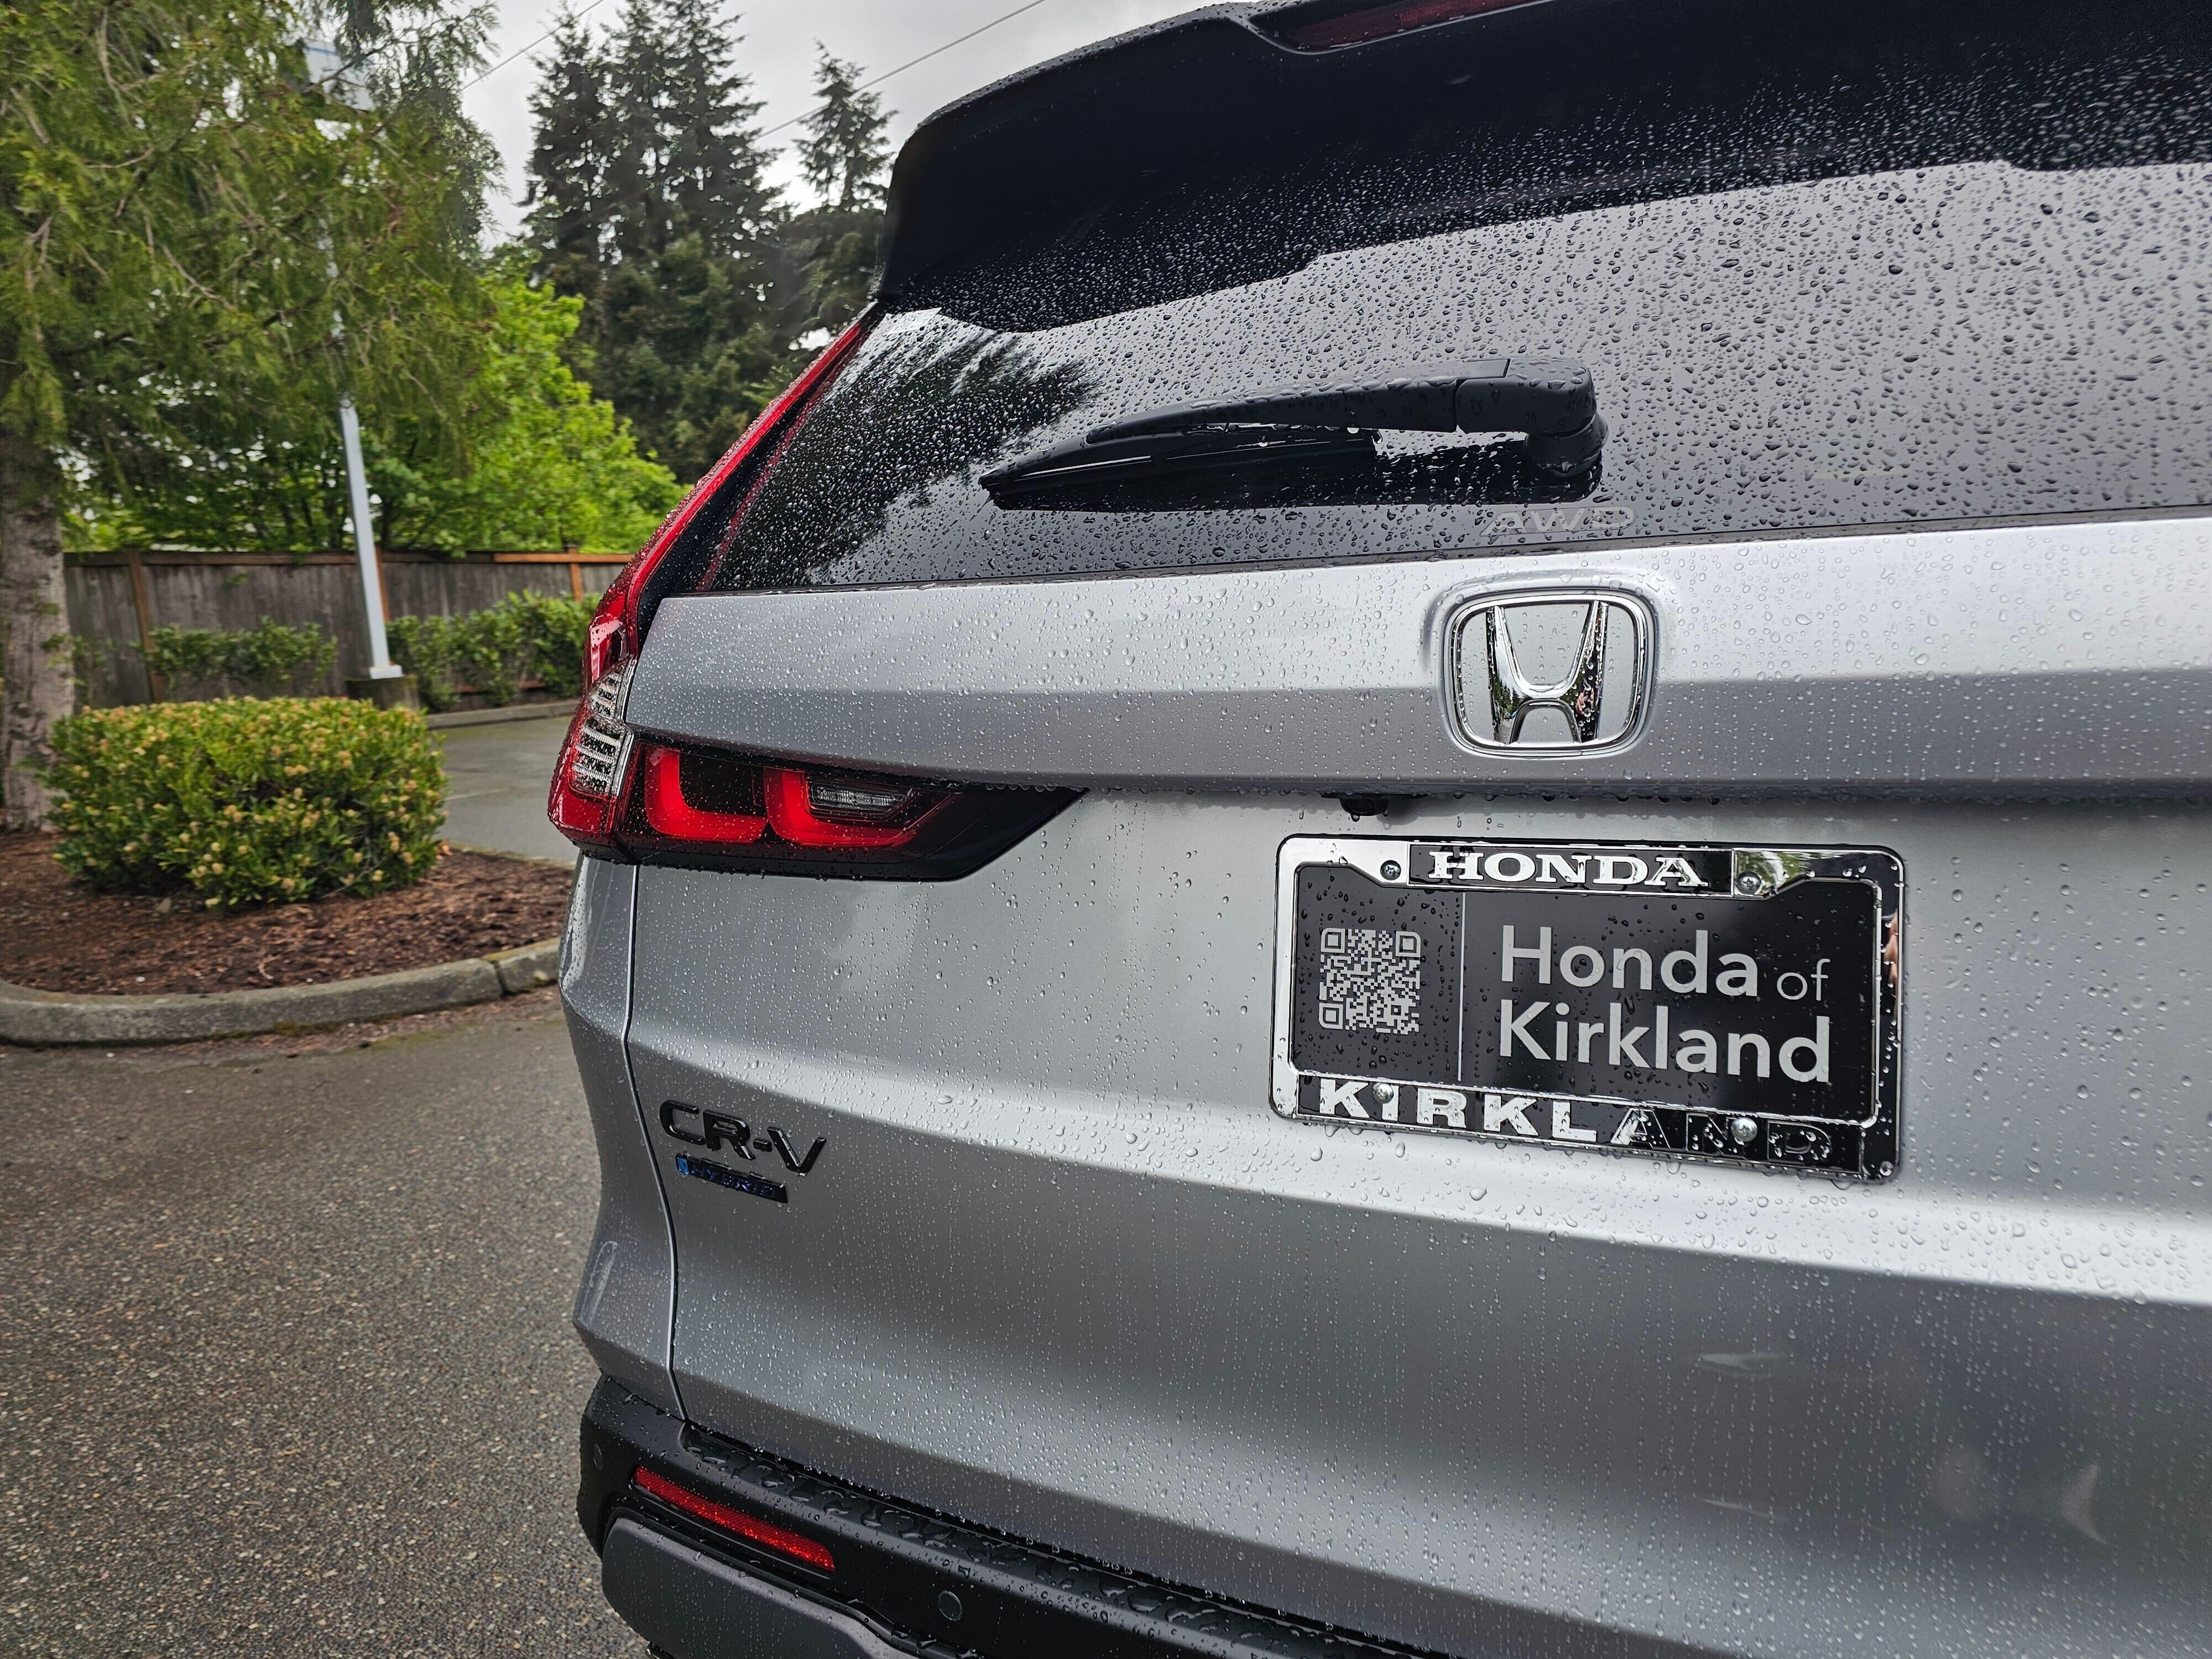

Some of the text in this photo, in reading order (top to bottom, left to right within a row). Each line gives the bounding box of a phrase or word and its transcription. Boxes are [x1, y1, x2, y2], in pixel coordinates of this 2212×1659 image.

[1480, 507, 1636, 536] AWD
[1428, 851, 1709, 887] HONDA
[1501, 925, 1831, 1001] Honda of
[1500, 999, 1830, 1083] Kirkland
[659, 1099, 827, 1175] CR-V
[1319, 1078, 1832, 1165] KIRKLAND
